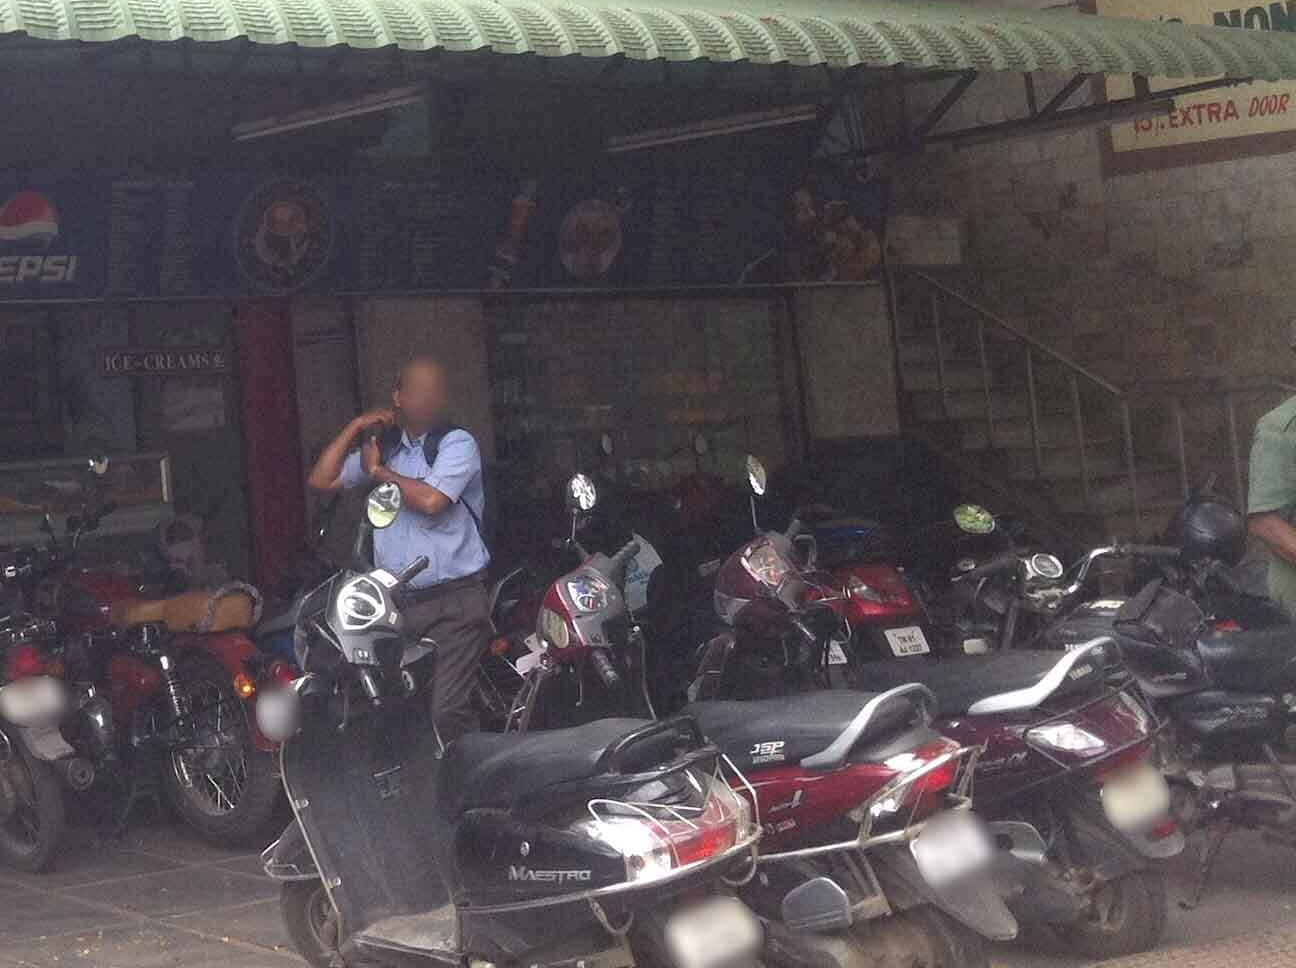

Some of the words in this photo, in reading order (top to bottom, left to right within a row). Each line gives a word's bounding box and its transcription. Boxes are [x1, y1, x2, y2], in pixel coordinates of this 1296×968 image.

[1168, 99, 1241, 129] EXTRA
[1247, 93, 1291, 118] DOOR
[508, 865, 592, 885] MAESTRO
